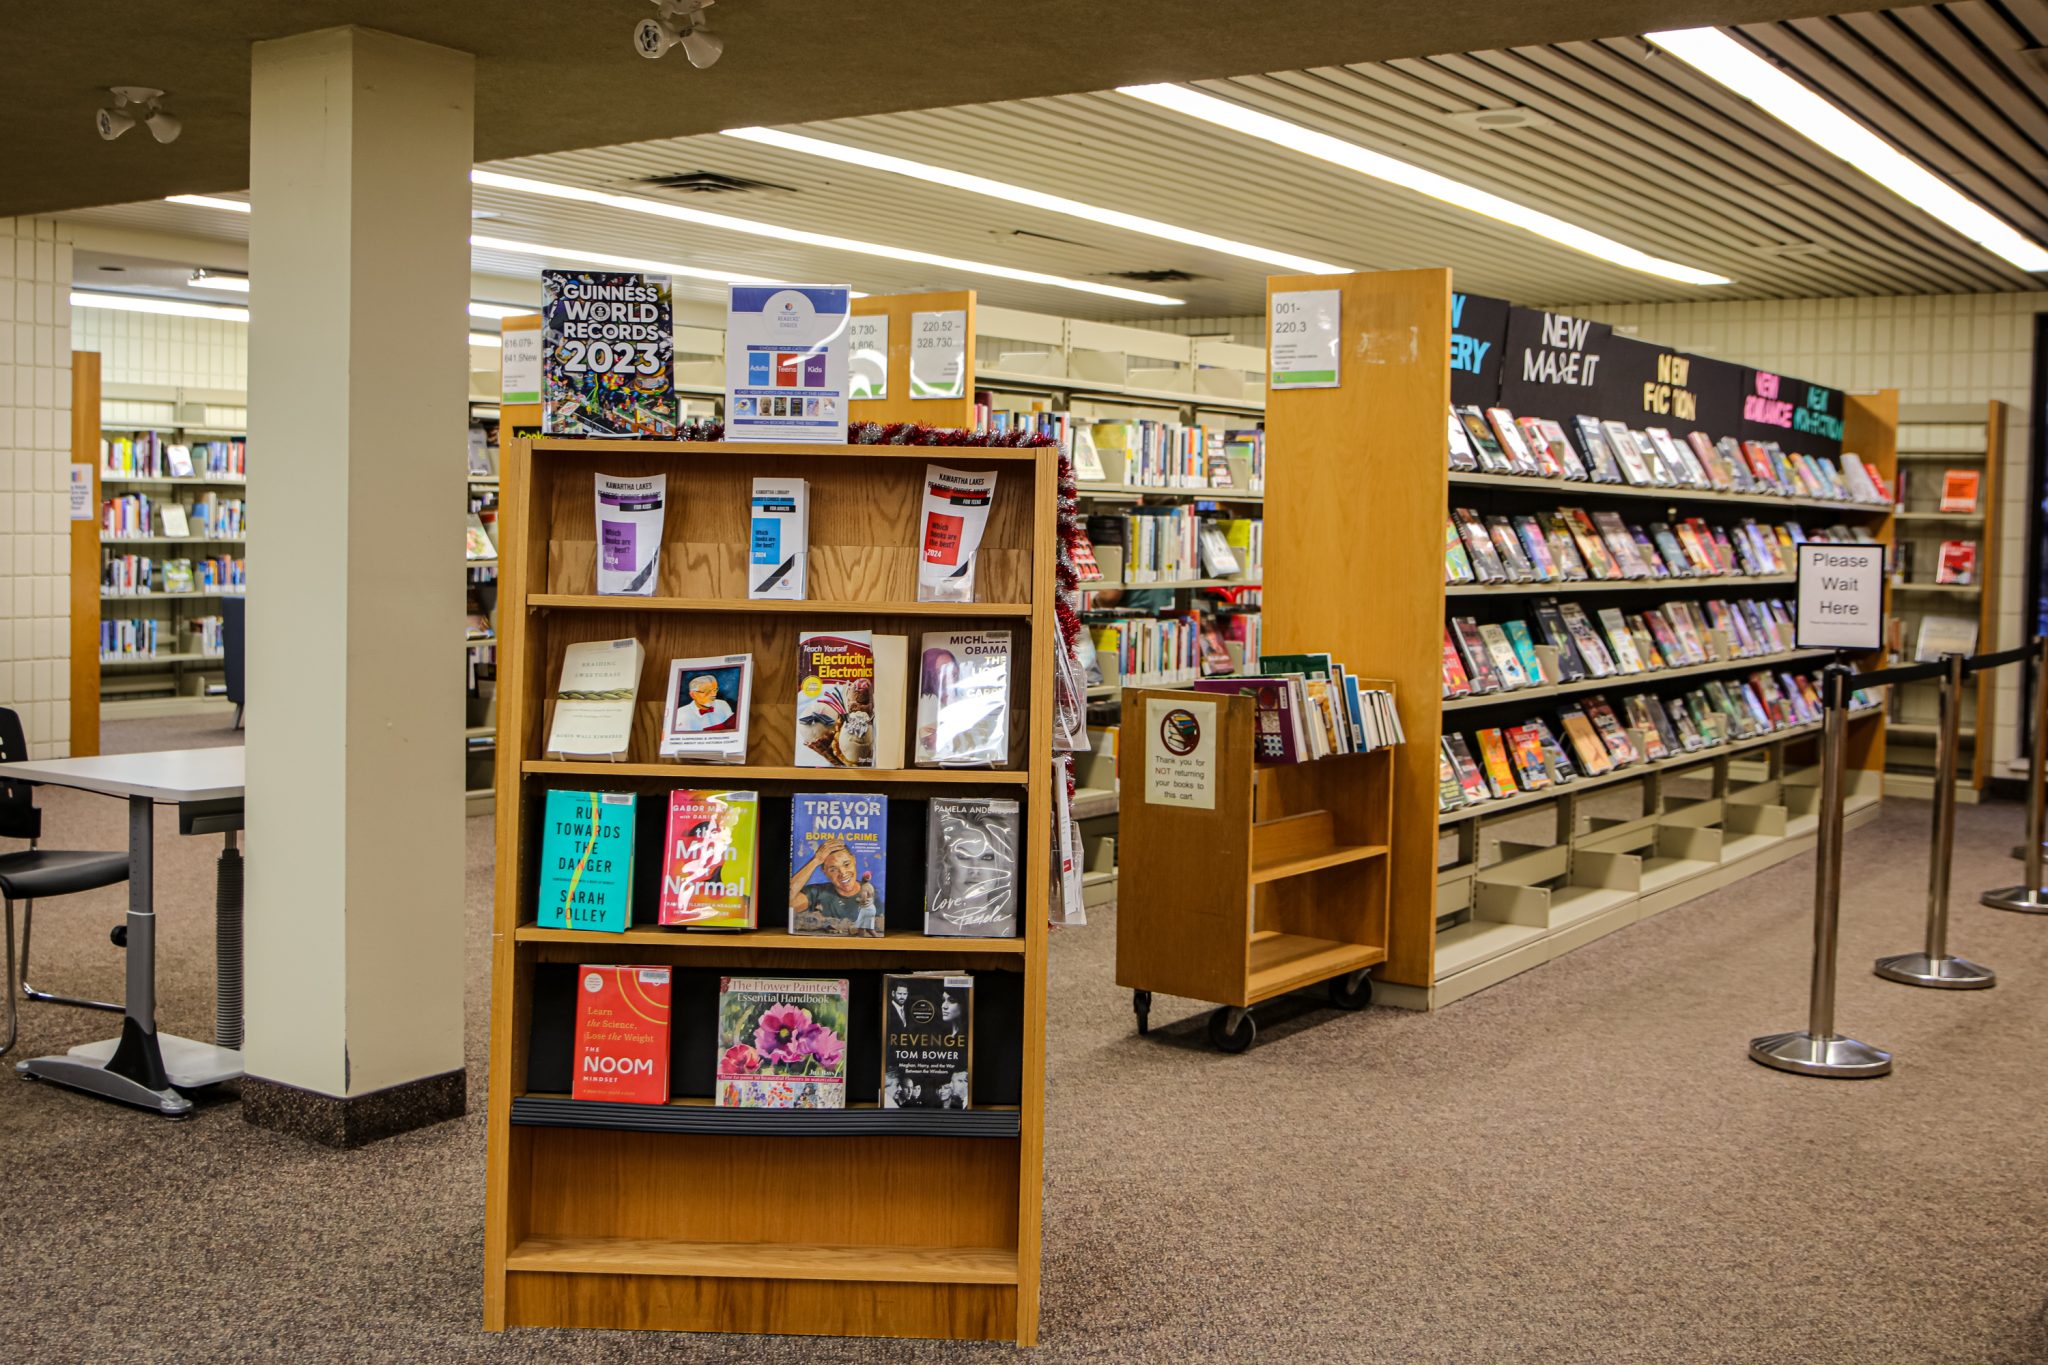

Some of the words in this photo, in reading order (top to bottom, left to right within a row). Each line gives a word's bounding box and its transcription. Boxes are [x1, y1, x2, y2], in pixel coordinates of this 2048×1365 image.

[564, 285, 658, 302] GUINNESS
[564, 301, 659, 323] WORLD
[1276, 303, 1300, 314] 001-
[564, 322, 659, 341] RECORDS
[848, 325, 878, 335] 8.730-
[923, 321, 952, 332] 220.52
[1276, 322, 1306, 333] 220.3
[1542, 312, 1590, 351] NEW
[917, 338, 952, 348] 328.730
[564, 341, 660, 375] 2023
[1523, 348, 1580, 384] MAKE
[1580, 354, 1600, 386] IT
[939, 473, 968, 484] KAWARTHA
[606, 482, 634, 490] KAWARTHA
[928, 549, 942, 557] 2024
[1813, 553, 1868, 567] Please
[1822, 578, 1858, 591] Wait
[1820, 601, 1859, 615] Here
[965, 646, 1008, 654] OBAMA
[812, 652, 866, 668] Electricity
[984, 656, 1006, 664] THE
[818, 666, 873, 678] Electronics
[1155, 755, 1176, 764] Thank
[1174, 769, 1204, 780] returning
[1174, 780, 1194, 789] books
[576, 806, 602, 820] RUN
[804, 801, 880, 816] TREVOR
[934, 805, 967, 813] PAMELA
[815, 816, 869, 830] NOAH
[556, 822, 620, 838] TOWARDS
[806, 832, 835, 841] BORN
[837, 832, 844, 840] A
[846, 833, 878, 842] CRIME
[575, 841, 598, 854] THE
[558, 858, 612, 872] DANGER
[664, 874, 744, 896] Normal
[560, 890, 605, 905] SARAH
[556, 906, 606, 922] POLLEY
[732, 981, 748, 990] The
[754, 981, 790, 992] Flower
[737, 993, 779, 1003] Essential
[781, 994, 830, 1004] Handbook
[588, 1006, 612, 1016] Learn
[602, 1020, 638, 1030] Science,
[586, 1032, 606, 1040] Lose
[608, 1032, 622, 1041] the
[624, 1034, 654, 1044] Weight
[890, 1034, 965, 1047] REVENGE
[896, 1050, 918, 1059] TOM
[922, 1051, 958, 1060] BOWER
[584, 1056, 653, 1076] NOOM
